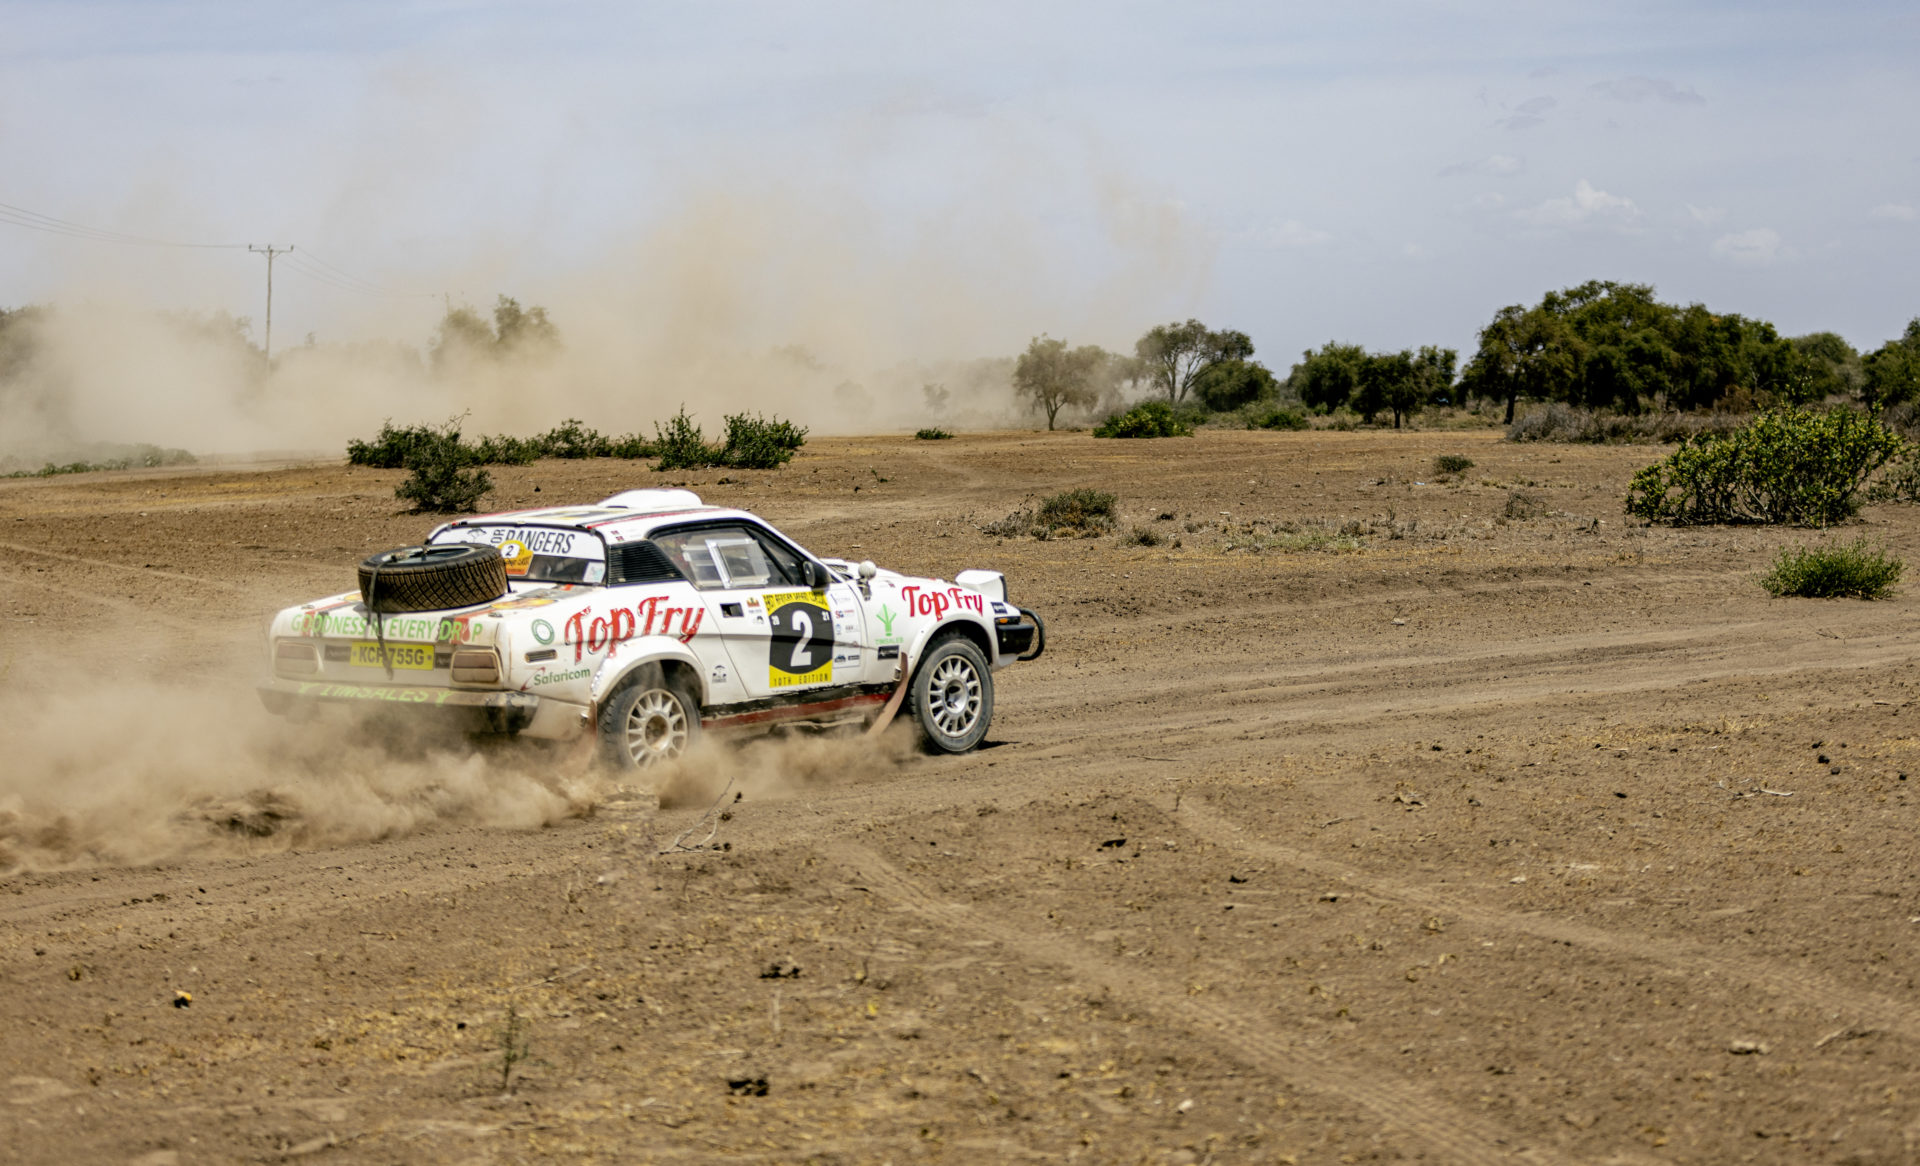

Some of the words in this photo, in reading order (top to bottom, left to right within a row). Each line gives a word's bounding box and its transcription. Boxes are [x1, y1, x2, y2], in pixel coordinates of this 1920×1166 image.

[505, 529, 575, 554] RANGERS
[505, 545, 514, 556] 2
[290, 614, 368, 635] GOODNESS
[389, 618, 436, 640] EVERY
[790, 610, 813, 667] 2
[388, 648, 424, 665] 755G
[533, 667, 591, 686] Safaricom
[774, 677, 791, 686] 10TH
[799, 673, 828, 685] EDITION
